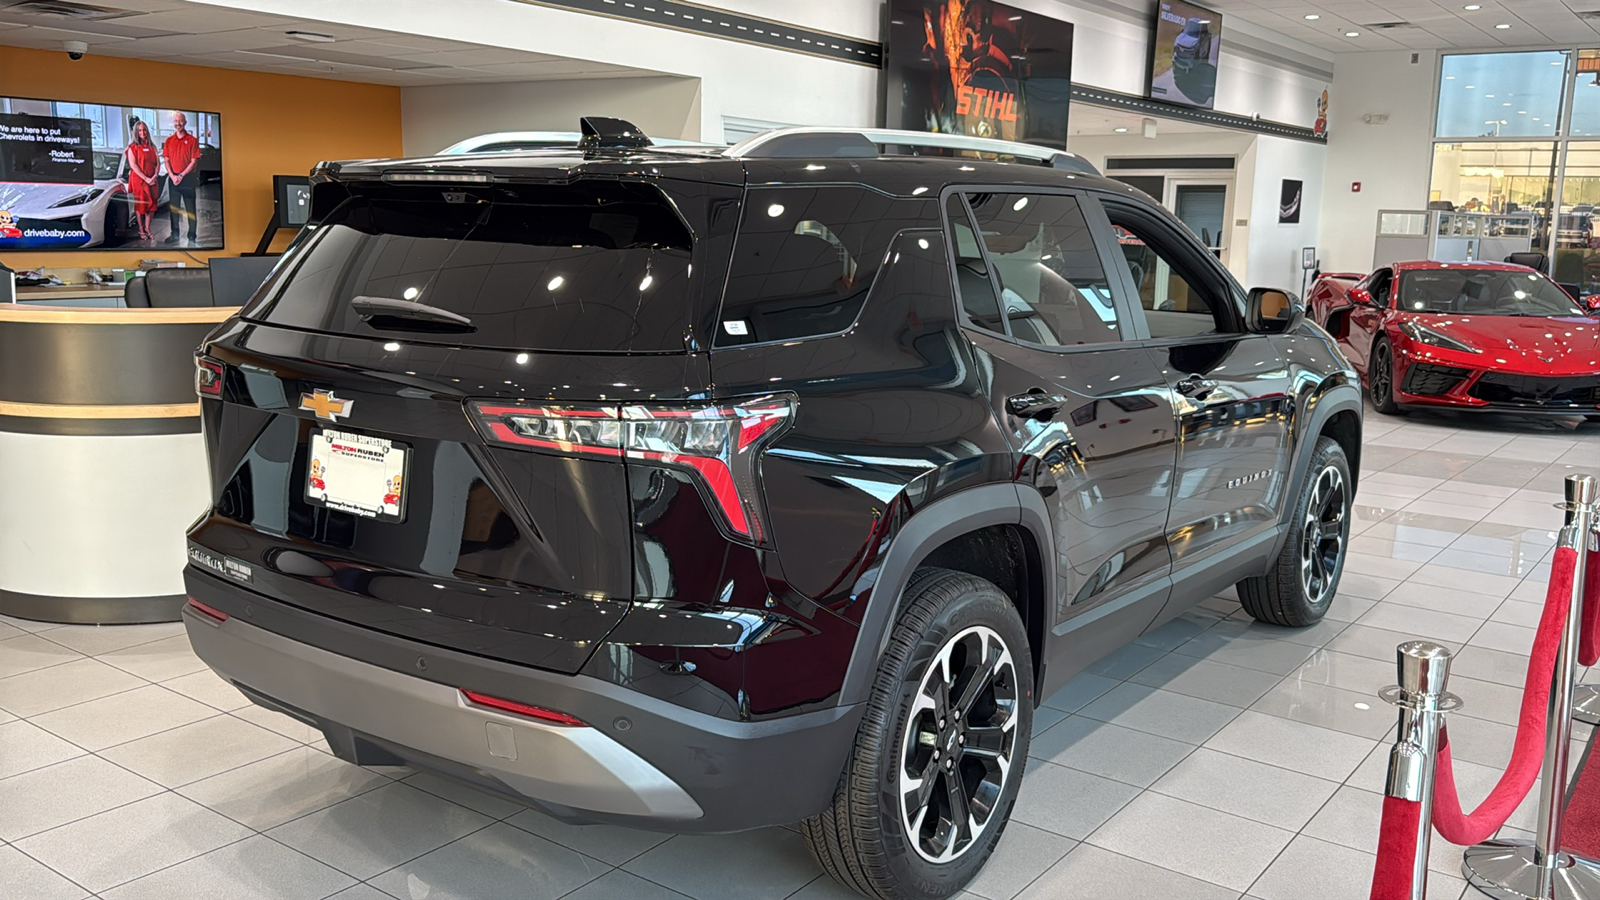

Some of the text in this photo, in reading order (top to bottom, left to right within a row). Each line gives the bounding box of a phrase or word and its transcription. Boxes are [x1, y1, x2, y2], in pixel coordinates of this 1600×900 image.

[956, 84, 1017, 122] STIHL
[24, 126, 40, 134] here
[49, 128, 61, 136] put
[0, 132, 35, 142] Chevrolets
[44, 135, 80, 145] driveways!
[24, 228, 85, 239] drivebaby.com
[331, 444, 385, 458] MILTON RUBEN
[1228, 468, 1273, 490] EQUINOX
